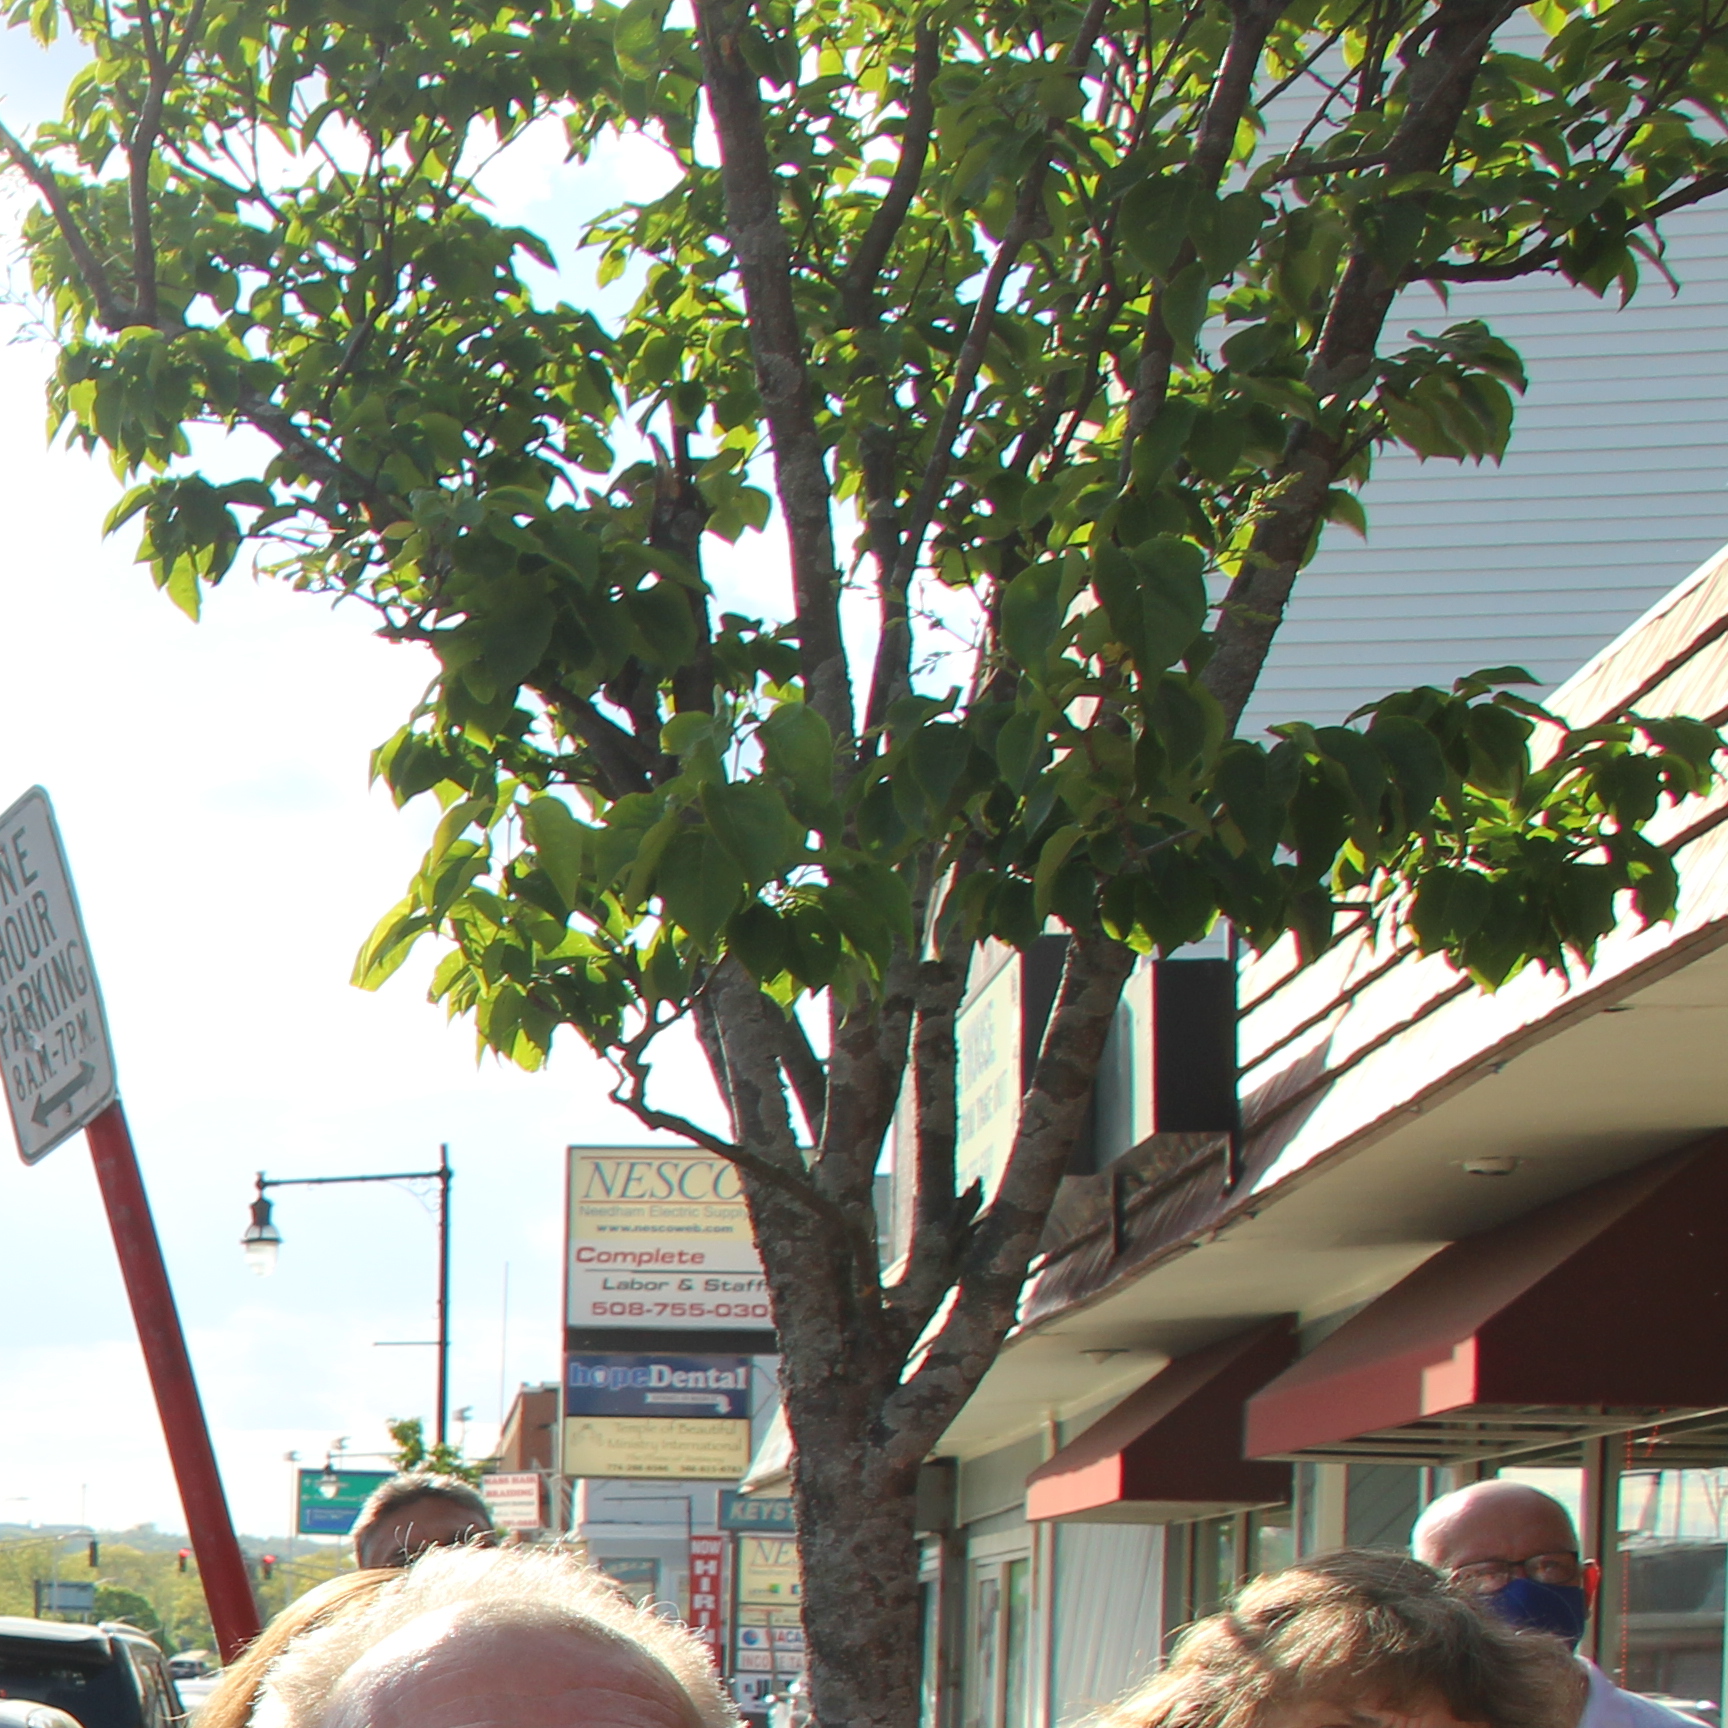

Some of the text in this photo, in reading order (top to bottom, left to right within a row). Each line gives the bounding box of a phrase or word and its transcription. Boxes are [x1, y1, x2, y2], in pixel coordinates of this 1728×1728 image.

[579, 1205, 645, 1218] Needham
[650, 1205, 701, 1217] Electric
[575, 1246, 705, 1267] Complete
[602, 1277, 669, 1291] Labor
[678, 1278, 694, 1291] &
[692, 1540, 721, 1554] NOW
